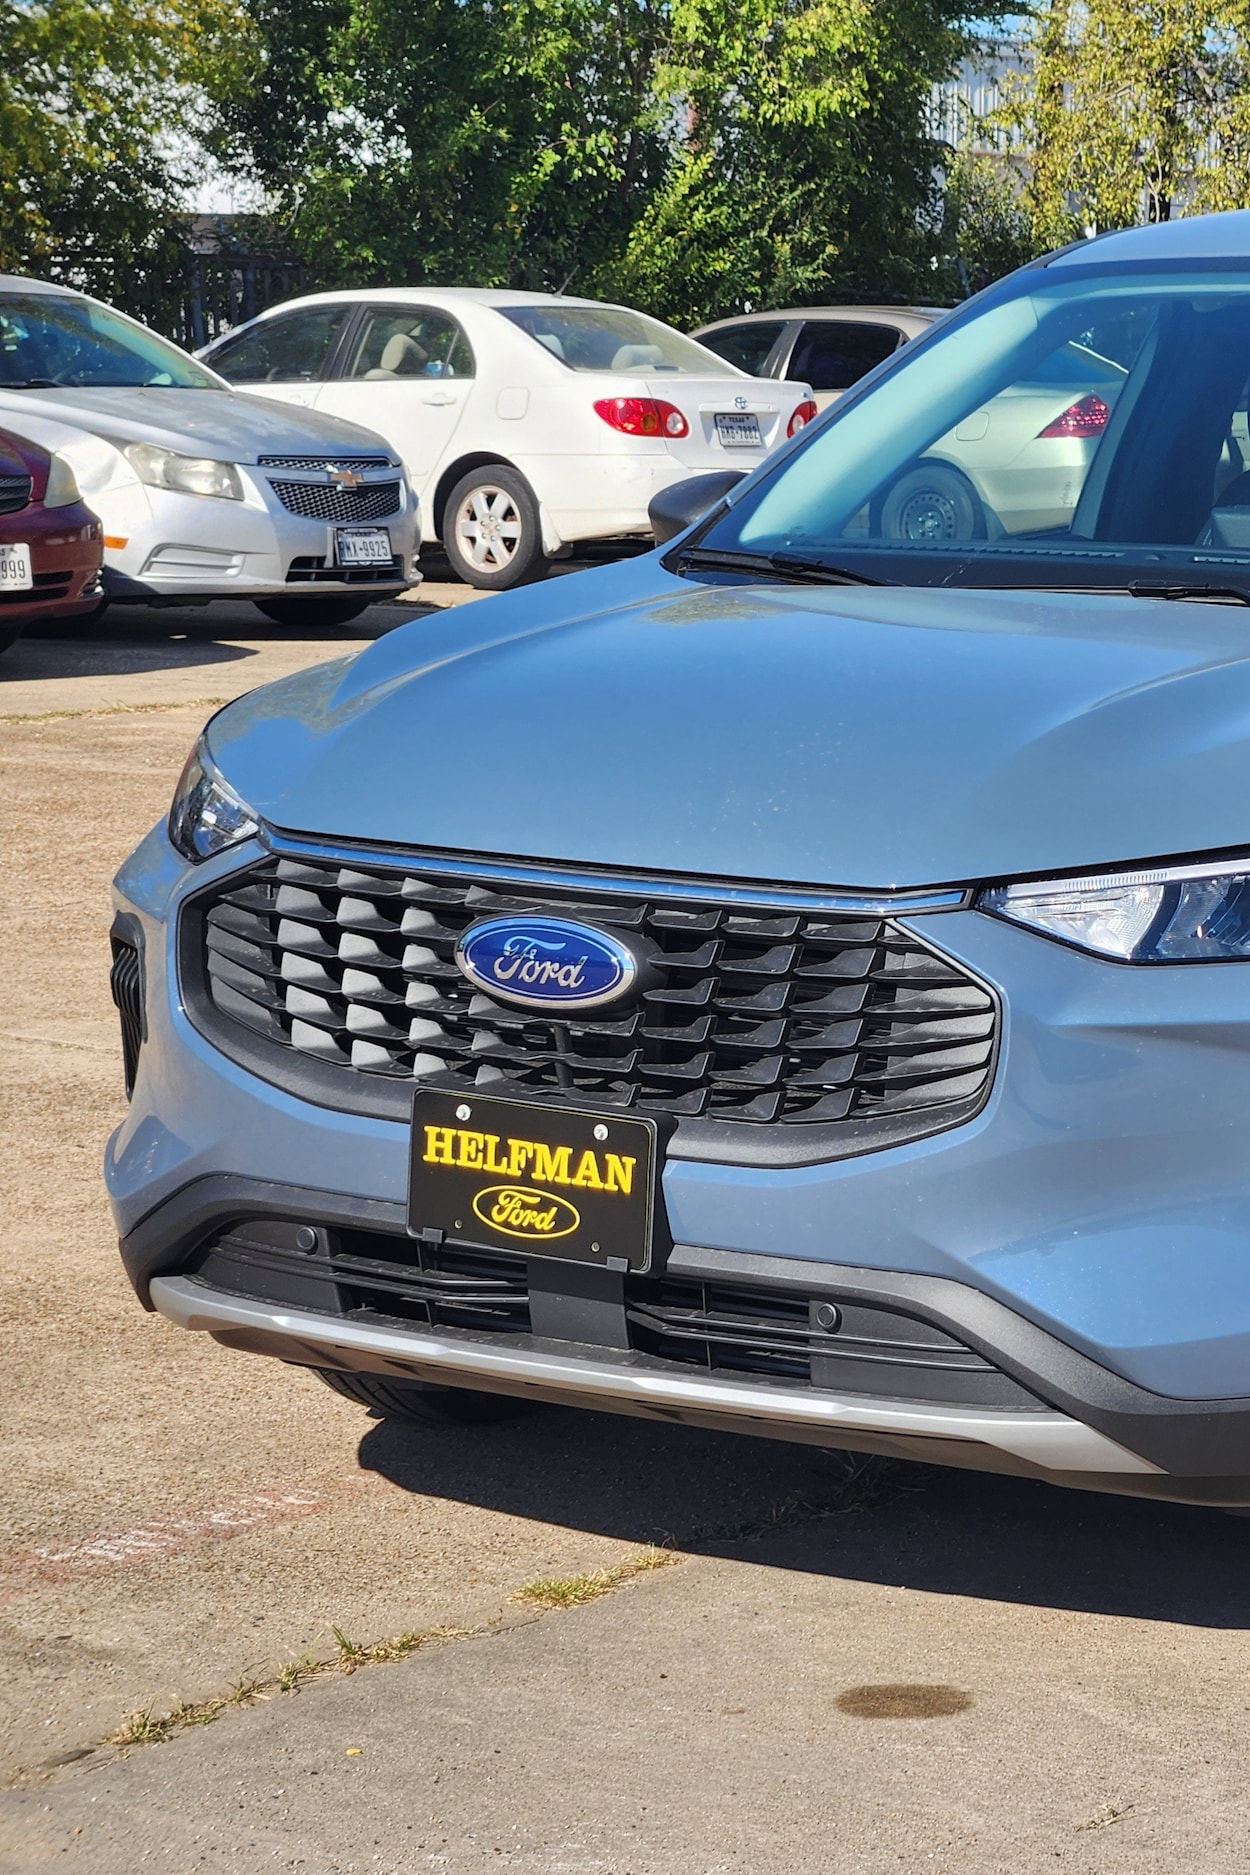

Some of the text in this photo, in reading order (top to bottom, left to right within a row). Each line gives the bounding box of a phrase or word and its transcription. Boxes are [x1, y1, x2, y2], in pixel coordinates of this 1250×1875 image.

[493, 935, 589, 989] Ford
[422, 1125, 637, 1194] HELFMAN
[491, 1190, 559, 1231] Ford
